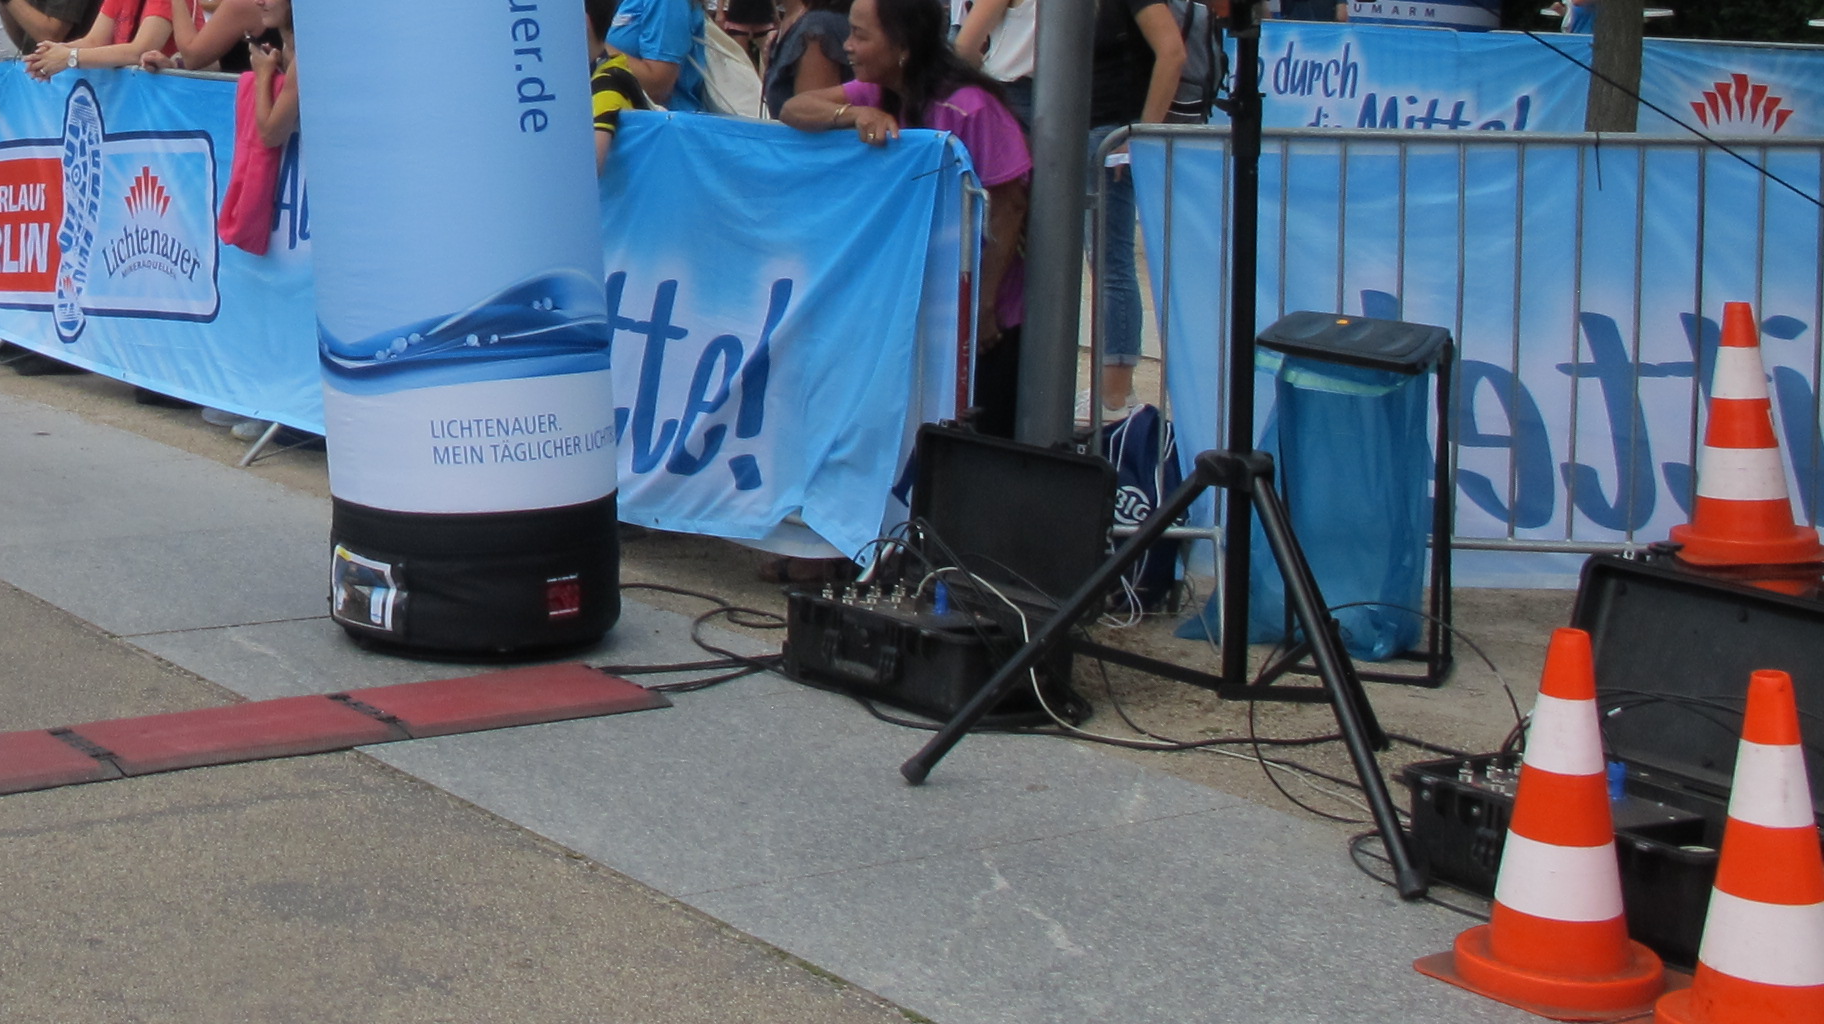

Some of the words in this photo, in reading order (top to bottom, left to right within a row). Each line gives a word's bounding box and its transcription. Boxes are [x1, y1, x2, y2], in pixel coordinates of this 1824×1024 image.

[1272, 41, 1359, 99] durch
[102, 224, 200, 283] Lichtenauer
[430, 413, 563, 439] LICHTENAUER.
[432, 445, 485, 465] MEIN
[489, 435, 582, 464] TÄGLICHER
